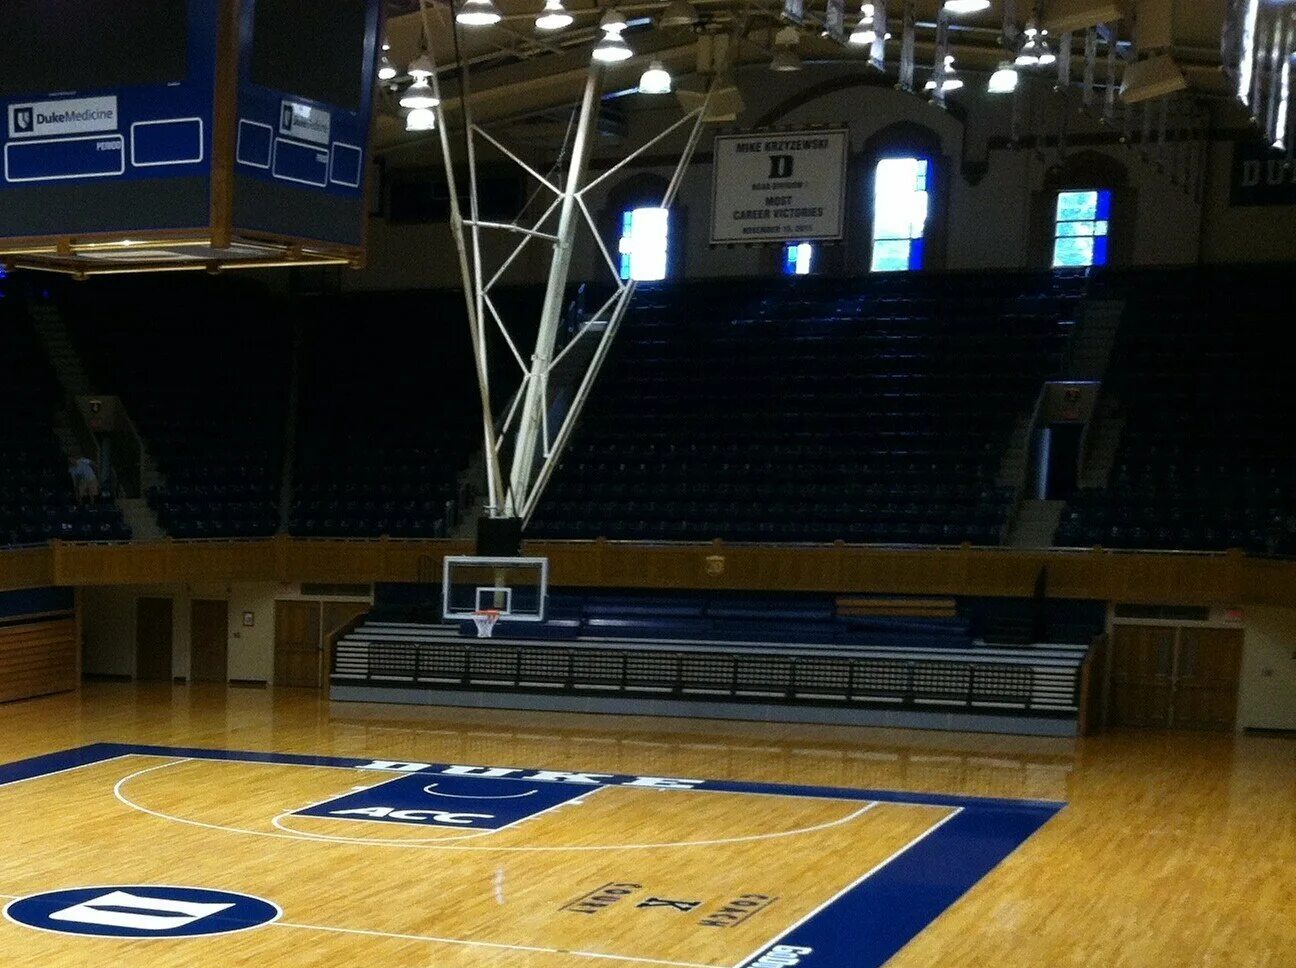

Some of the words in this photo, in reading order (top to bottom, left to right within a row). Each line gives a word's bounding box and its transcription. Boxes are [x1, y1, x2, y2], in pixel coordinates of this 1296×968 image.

[36, 109, 114, 125] DukeMedicine
[736, 141, 762, 153] MIKE
[768, 154, 794, 179] D
[765, 195, 793, 207] MOST
[733, 209, 771, 221] CAREER
[773, 206, 824, 219] VICTORIES
[356, 760, 705, 789] DUKE
[329, 806, 496, 824] ACC
[566, 882, 644, 915] COURT
[697, 893, 770, 928] COACH
